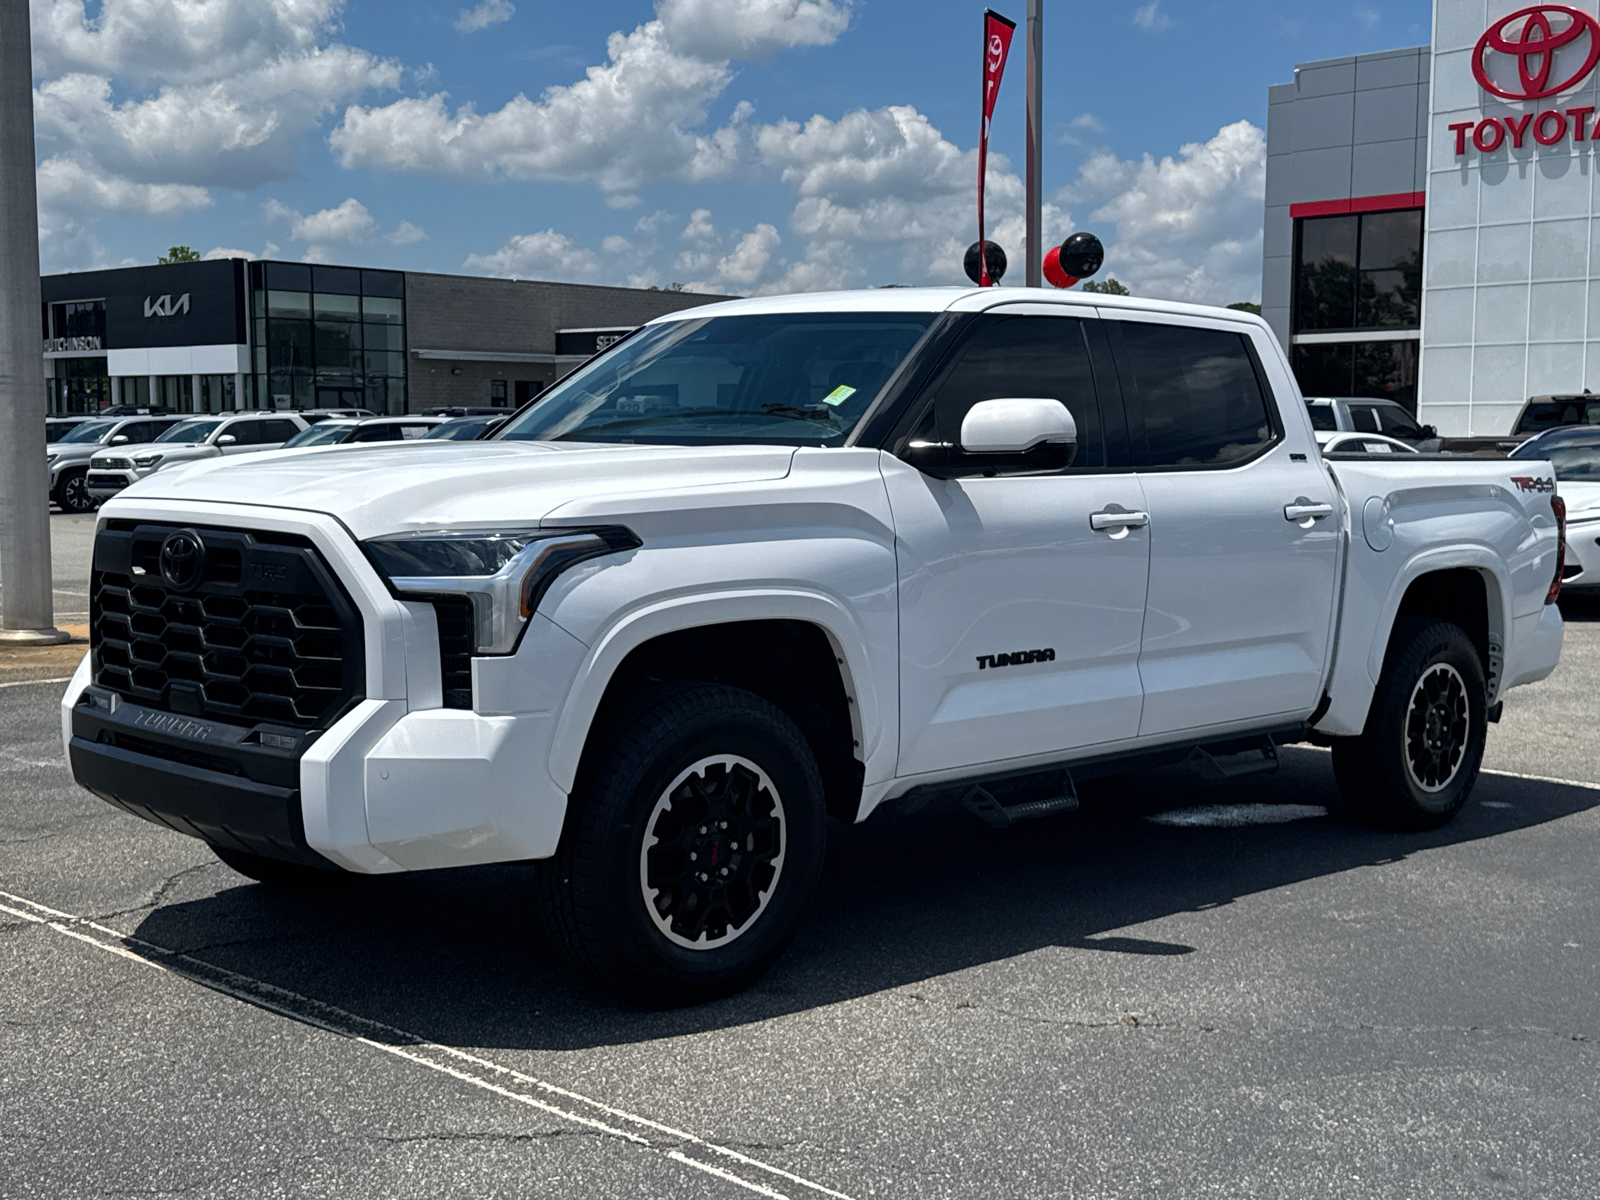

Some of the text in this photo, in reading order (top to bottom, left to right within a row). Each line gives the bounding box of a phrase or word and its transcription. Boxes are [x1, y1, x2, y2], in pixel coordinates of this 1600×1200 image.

[43, 336, 101, 352] HUTCHINSON
[976, 647, 1056, 670] TUNDRA
[134, 710, 215, 739] TUNDRA
